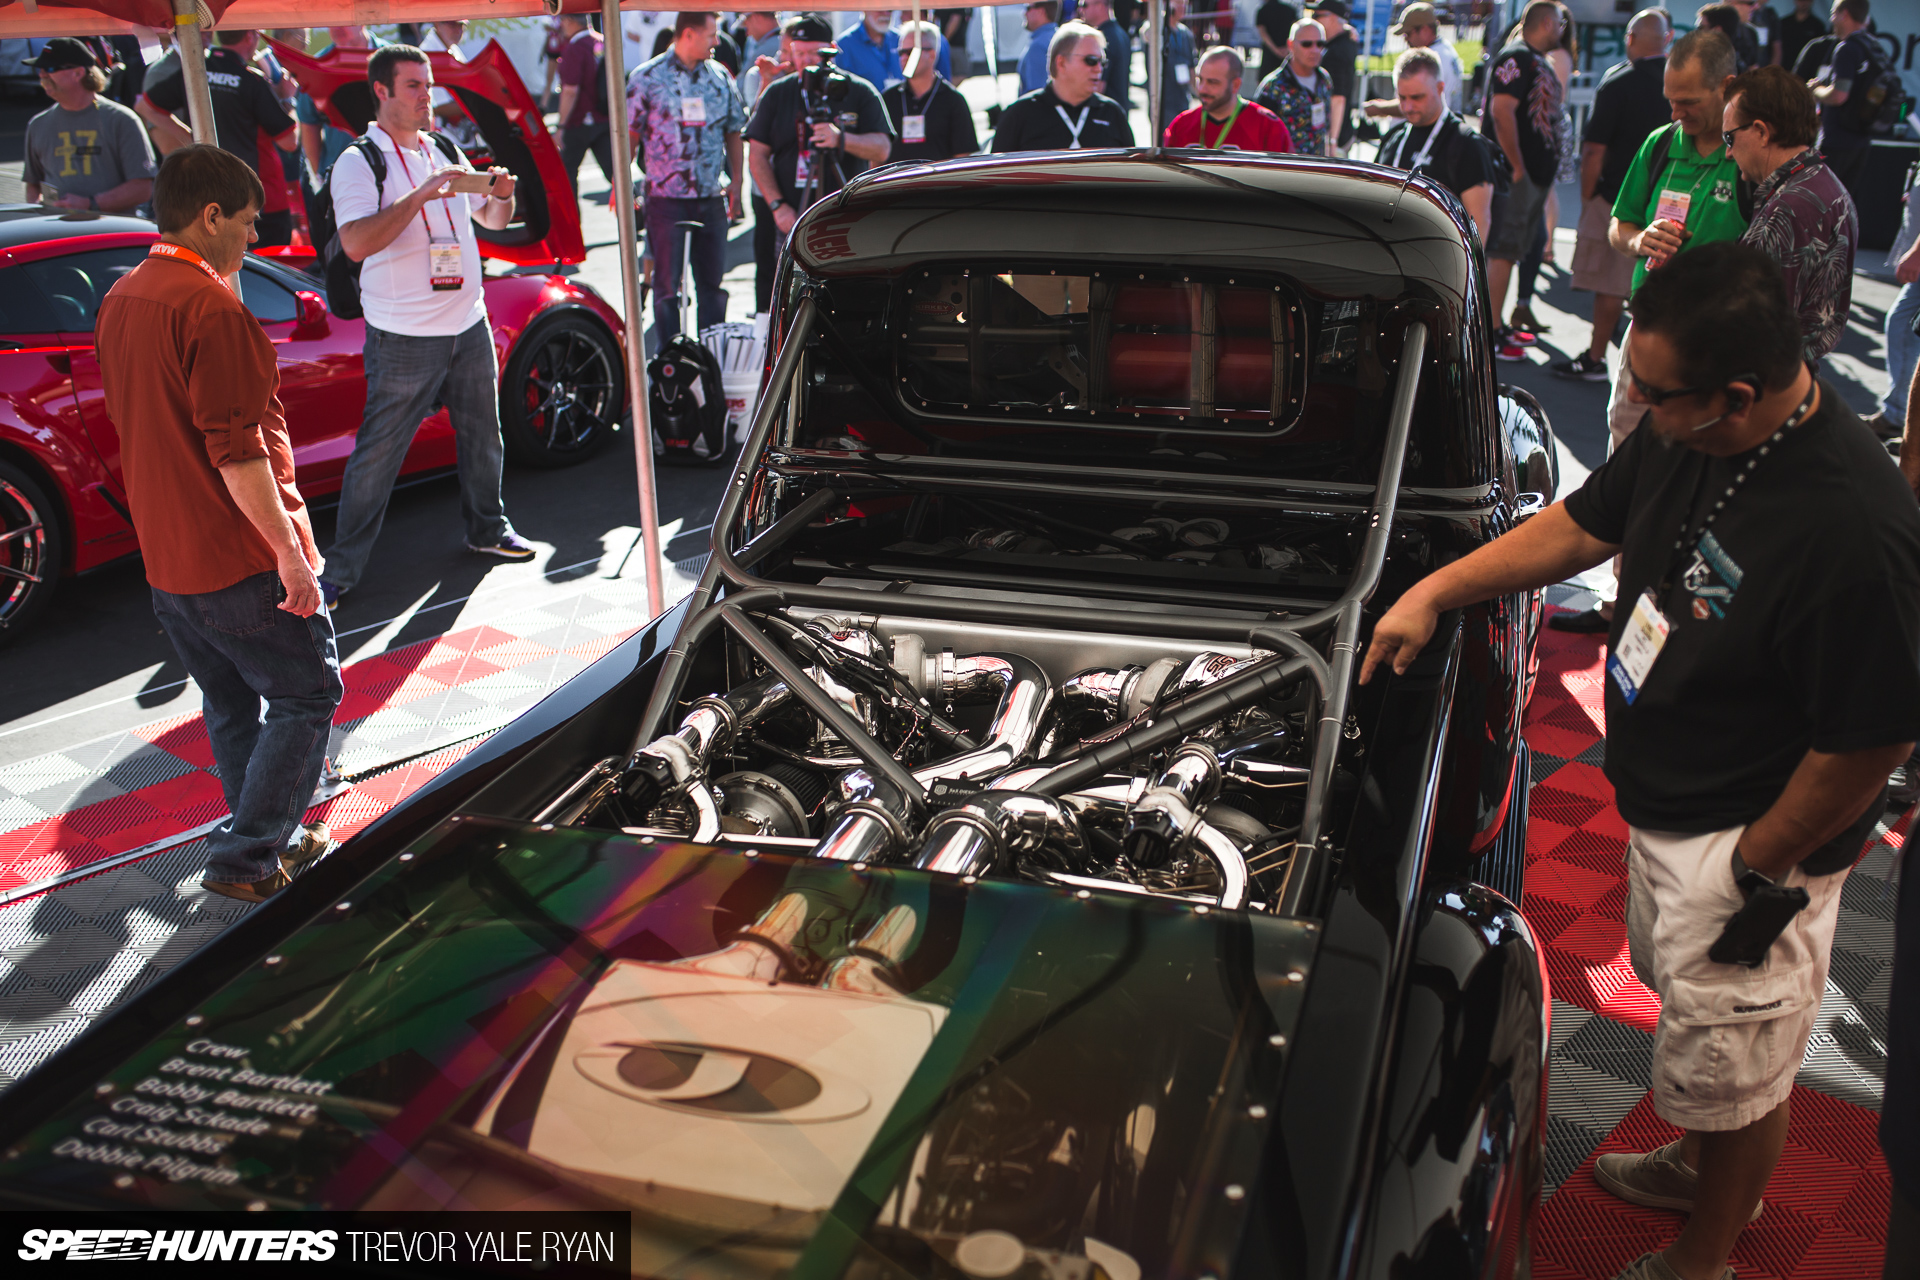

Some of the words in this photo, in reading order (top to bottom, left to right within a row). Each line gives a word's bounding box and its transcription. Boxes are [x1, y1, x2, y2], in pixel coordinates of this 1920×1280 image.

[187, 1039, 250, 1058] Crew
[160, 1058, 233, 1081] Brent
[230, 1068, 334, 1096] Bartlett
[111, 1096, 178, 1122] Craig
[176, 1107, 271, 1135] Sckade
[134, 1077, 216, 1103] Bobby
[213, 1089, 319, 1118] Bartlett
[83, 1117, 143, 1139] Carl
[138, 1125, 225, 1155] Stubbs
[53, 1138, 145, 1168] Debbie
[145, 1153, 241, 1185] Pilgrim
